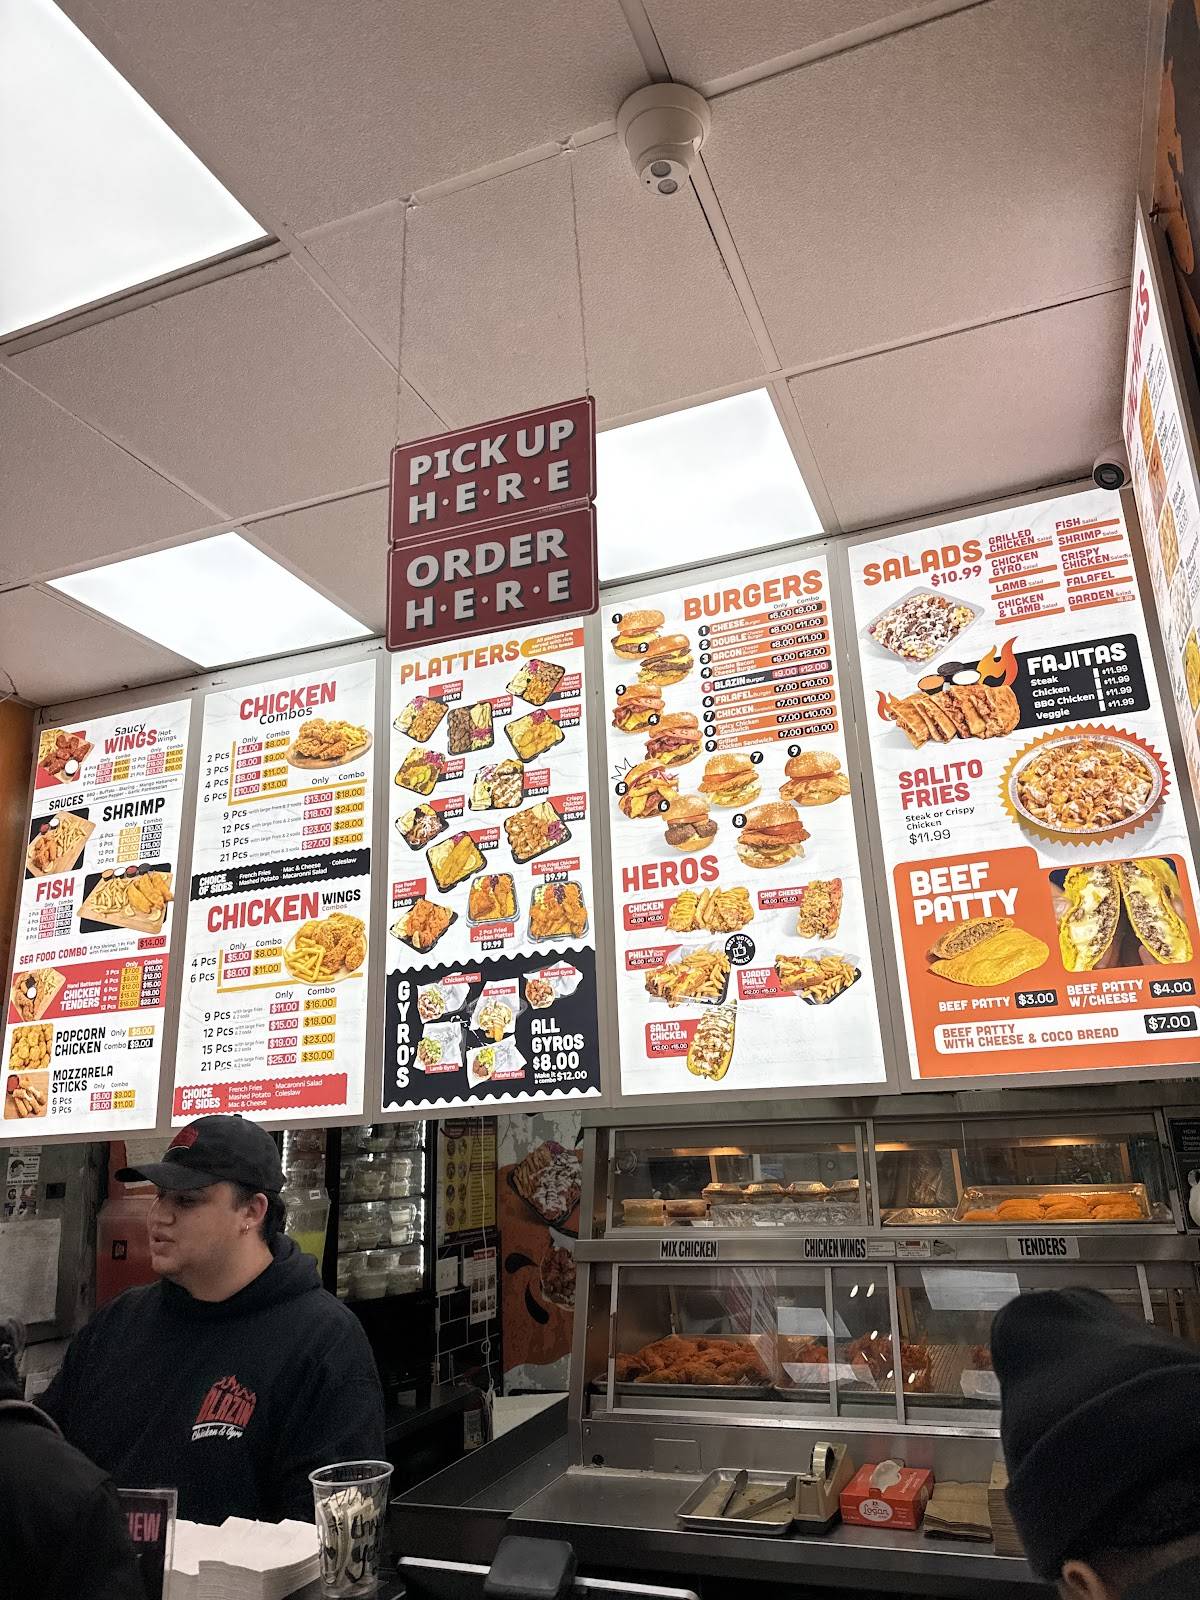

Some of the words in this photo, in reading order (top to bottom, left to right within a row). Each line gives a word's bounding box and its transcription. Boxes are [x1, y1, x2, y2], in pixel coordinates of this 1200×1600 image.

[409, 433, 508, 486] PICK
[516, 419, 574, 457] UP
[1056, 518, 1081, 529] FISH
[988, 529, 1031, 544] GRILLED
[1059, 530, 1101, 546] SHRIMP
[990, 536, 1035, 553] CHICKEN
[406, 528, 568, 588] ORDER
[991, 552, 1038, 567] CHICKEN
[1061, 547, 1099, 562] CRISPY
[1063, 554, 1109, 570] CHICKEN
[863, 540, 982, 586] SALADS
[993, 564, 1022, 576] GYRO
[931, 566, 981, 587] $10.99
[1067, 571, 1115, 586] FALAFEL
[996, 580, 1027, 592] LAMB
[684, 569, 823, 621] BURGERS
[998, 593, 1044, 609] CHICKEN
[1068, 589, 1114, 605] GARDEN
[1000, 610, 1007, 618] &
[1011, 602, 1041, 616] LAMB
[712, 620, 744, 632] CHEESE
[713, 635, 746, 646] DOUBLE
[401, 639, 519, 684] PLATTERS
[713, 649, 741, 660] BACON
[1027, 643, 1127, 675] FAJITAS
[1030, 676, 1058, 686] Steak
[1102, 665, 1128, 674] $11.99
[715, 677, 746, 690] BLAZIN
[1033, 685, 1070, 697] Chicken
[1104, 676, 1130, 686] $11.99
[240, 681, 337, 720] CHICKEN
[716, 691, 752, 704] FALAFEL
[1034, 698, 1055, 709] BBQ
[1057, 693, 1094, 704] Chicken
[1106, 686, 1132, 696] $11.99
[260, 706, 313, 725] Combos
[717, 706, 753, 718] CHICKEN
[1036, 708, 1070, 720] Veggie
[1108, 698, 1134, 707] $11.99
[115, 722, 146, 736] Saucy
[243, 735, 258, 744] Only
[266, 729, 290, 739] Combo
[105, 729, 157, 754] WINGS
[158, 735, 176, 743] Wings
[312, 776, 329, 785] Only
[339, 771, 365, 780] Combo
[898, 759, 983, 790] SALITO
[336, 788, 362, 799] $18.00
[901, 782, 971, 811] FRIES
[49, 795, 84, 810] SAUCES
[103, 798, 165, 822] SHRIMP
[336, 803, 362, 814] $24.00
[905, 812, 931, 823] Steak
[946, 806, 975, 818] Crispy
[334, 819, 362, 831] $28.00
[907, 819, 941, 830] Chicken
[302, 839, 329, 848] $27.00
[333, 834, 362, 844] $34.00
[910, 829, 950, 845] $11.99
[332, 857, 357, 866] Coleslaw
[200, 874, 226, 886] CHOICE
[622, 855, 719, 892] HEROS
[910, 862, 989, 897] BEEF
[36, 878, 75, 902] FISH
[200, 885, 209, 895] OF
[211, 881, 233, 893] SIDES
[778, 888, 802, 897] CHEESE
[207, 892, 319, 933] CHICKEN
[322, 889, 361, 904] WINGS
[322, 903, 347, 911] Combos
[629, 902, 663, 912] CHICKEN
[913, 888, 1019, 925] PATTY
[230, 942, 246, 951] Only
[256, 938, 282, 947] Combo
[20, 954, 33, 965] SEA
[36, 951, 57, 963] FOOD
[58, 947, 88, 961] COMBO
[228, 952, 249, 962] $5.00
[255, 948, 277, 957] $8.00
[629, 950, 652, 959] PHILLY
[226, 968, 248, 978] $8.00
[254, 964, 278, 975] $11.00
[741, 970, 770, 978] LOADED
[742, 977, 767, 985] PHILLY
[1067, 984, 1098, 996] BEEF
[1102, 979, 1144, 993] PATTY
[64, 988, 100, 1000] CHICKEN
[276, 991, 293, 1000] Only
[308, 986, 335, 996] Combo
[1069, 991, 1137, 1007] W/CHEESE
[1153, 981, 1192, 995] $4.00
[60, 998, 99, 1011] TENDERS
[938, 999, 969, 1012] BEEF
[971, 996, 1010, 1009] PATTY
[1018, 991, 1054, 1006] $3.00
[214, 1010, 230, 1021] Pcs
[272, 1003, 297, 1013] $11.00
[305, 999, 333, 1009] $16.00
[271, 1019, 297, 1029] $15.00
[304, 1016, 332, 1026] $18.00
[532, 1018, 560, 1034] ALL
[650, 1023, 680, 1032] SALITO
[942, 1027, 972, 1039] BEEF
[976, 1024, 1015, 1036] PATTY
[1149, 1015, 1190, 1030] $7.00
[56, 1028, 106, 1043] POPCORN
[111, 1028, 126, 1036] Only
[304, 1034, 332, 1044] $23.00
[651, 1030, 687, 1040] CHICKEN
[944, 1036, 974, 1049] WITH
[978, 1034, 1025, 1047] CHEESE
[1028, 1034, 1036, 1043] &
[1041, 1031, 1073, 1043] COCO
[1078, 1027, 1119, 1039] BREAD
[55, 1042, 101, 1056] CHICKEN
[104, 1042, 126, 1050] Combo
[130, 1040, 150, 1048] $9.00
[532, 1034, 584, 1054] GYROS
[303, 1051, 332, 1061] $30.00
[533, 1052, 579, 1071] $8.00
[53, 1066, 113, 1081] MOZZARELA
[557, 1071, 587, 1081] $12.00
[52, 1081, 87, 1093] STICKS
[307, 1079, 322, 1087] Salad
[183, 1087, 213, 1099] CHOICE
[229, 1092, 249, 1100] Mashed
[113, 1100, 133, 1108] $11.00
[182, 1100, 193, 1110] OF
[195, 1098, 220, 1109] SIDES
[661, 1241, 678, 1257] MIX
[679, 1241, 716, 1257] CHICKEN
[804, 1238, 838, 1257] CHICKEN
[839, 1238, 865, 1257] WINGS
[1018, 1238, 1067, 1255] TENDERS
